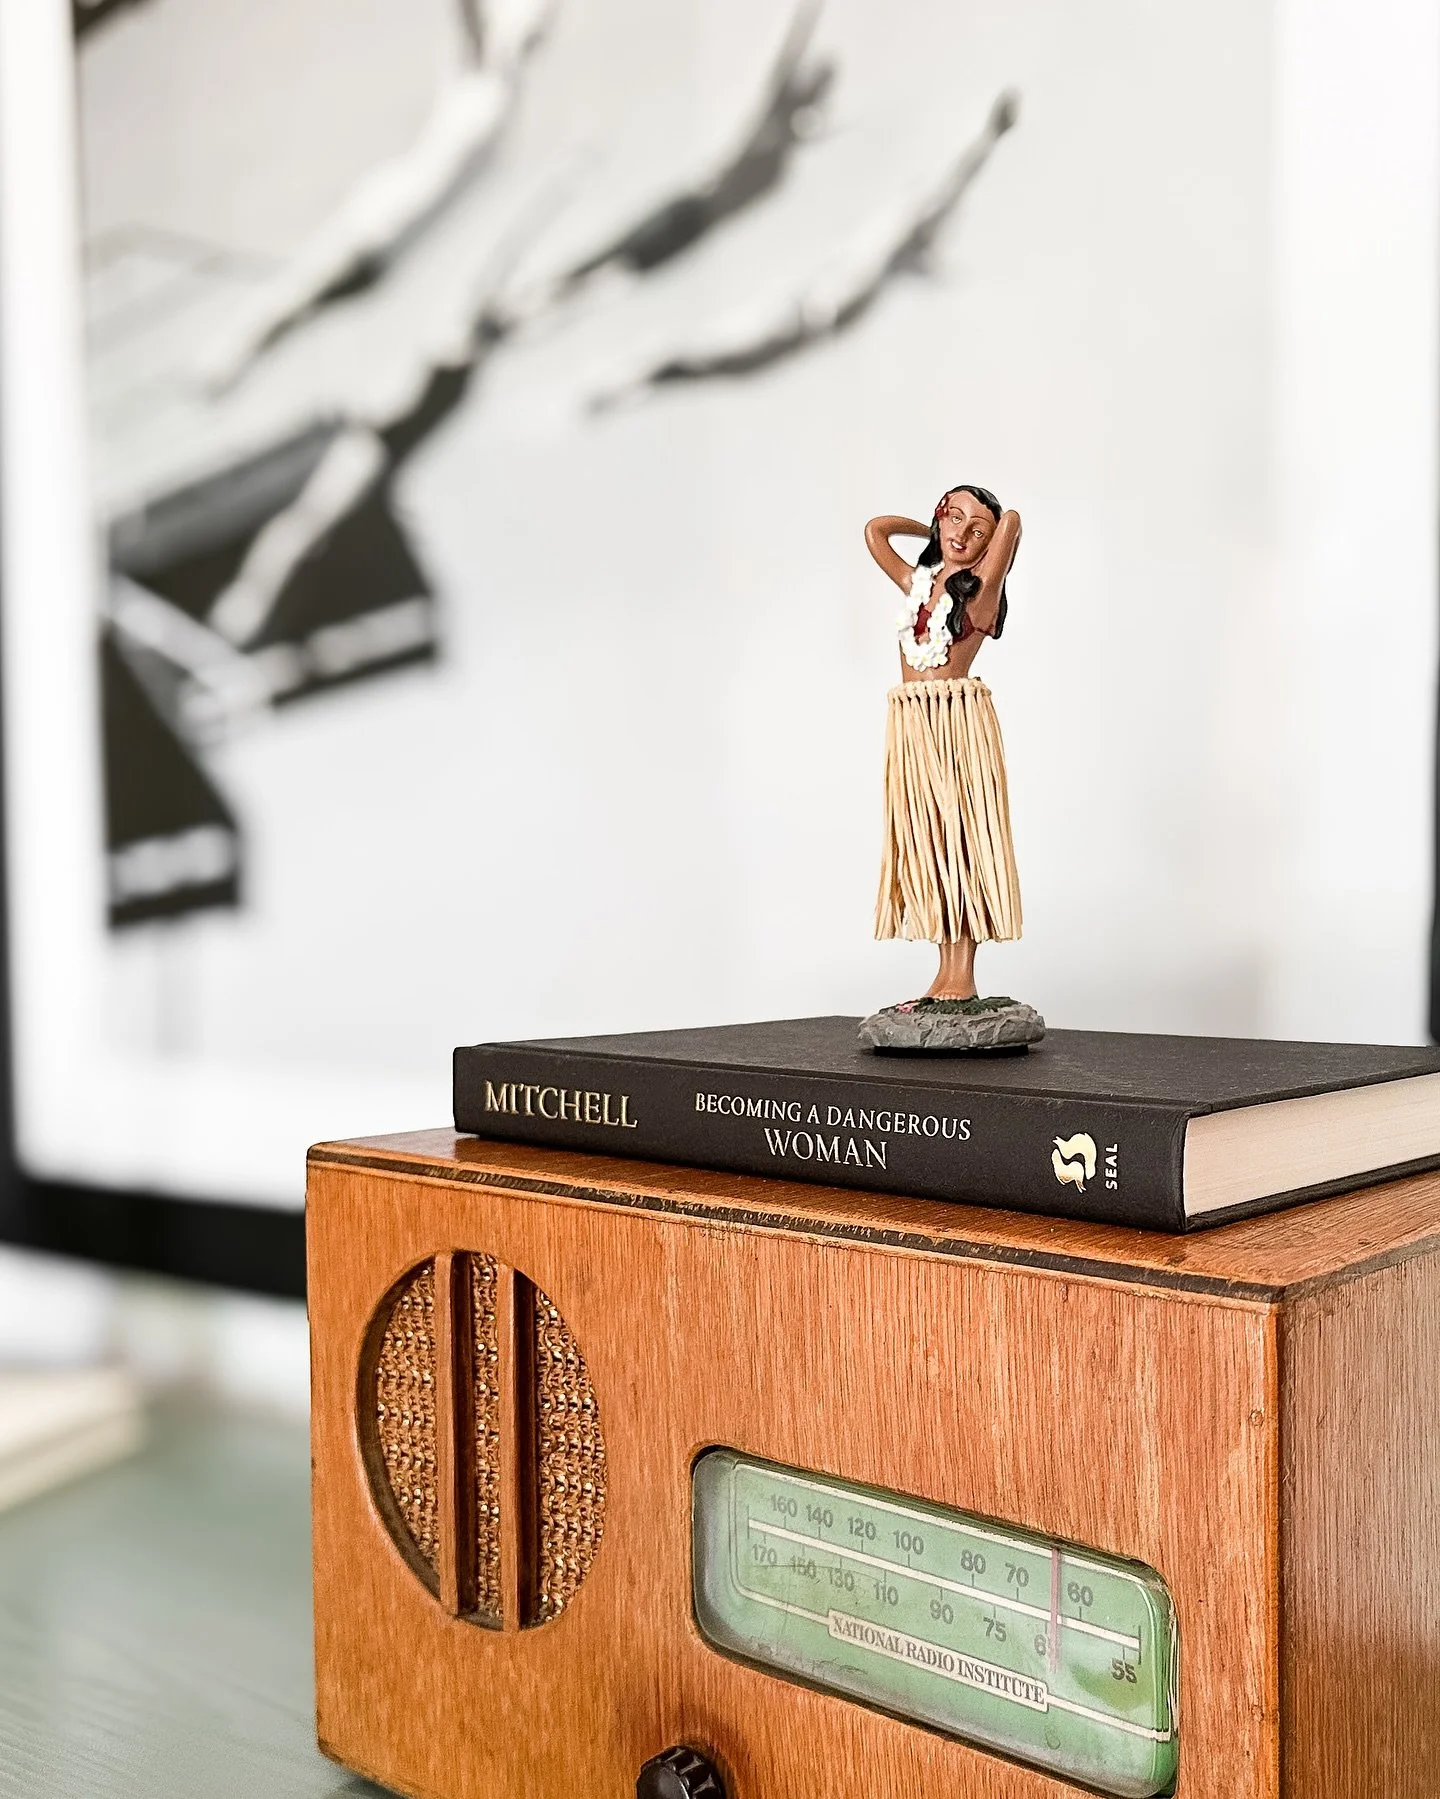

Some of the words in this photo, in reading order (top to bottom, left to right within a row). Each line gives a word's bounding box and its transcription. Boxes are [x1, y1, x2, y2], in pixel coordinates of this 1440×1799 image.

[484, 1080, 638, 1129] MITCHELL
[694, 1092, 802, 1122] BECOMING
[806, 1104, 820, 1125] A
[826, 1105, 972, 1141] DANGEROUS
[763, 1127, 888, 1170] WOMAN
[1105, 1143, 1118, 1190] SEAL
[771, 1493, 798, 1518] 160
[806, 1503, 834, 1528] 140
[847, 1517, 877, 1540] 120
[893, 1530, 924, 1555] 100
[960, 1549, 986, 1575] 80
[1004, 1562, 1030, 1588] 70
[1067, 1582, 1094, 1608] 60
[752, 1543, 777, 1565] 170
[828, 1567, 855, 1591] 130
[873, 1581, 899, 1606] 110
[929, 1600, 954, 1624] 90
[982, 1616, 1007, 1642] 75
[1034, 1634, 1051, 1656] 6
[1111, 1658, 1138, 1684] 55
[832, 1616, 902, 1654] NATIONAL
[905, 1642, 955, 1672] RADIO
[957, 1658, 1045, 1704] INSTITUTE
